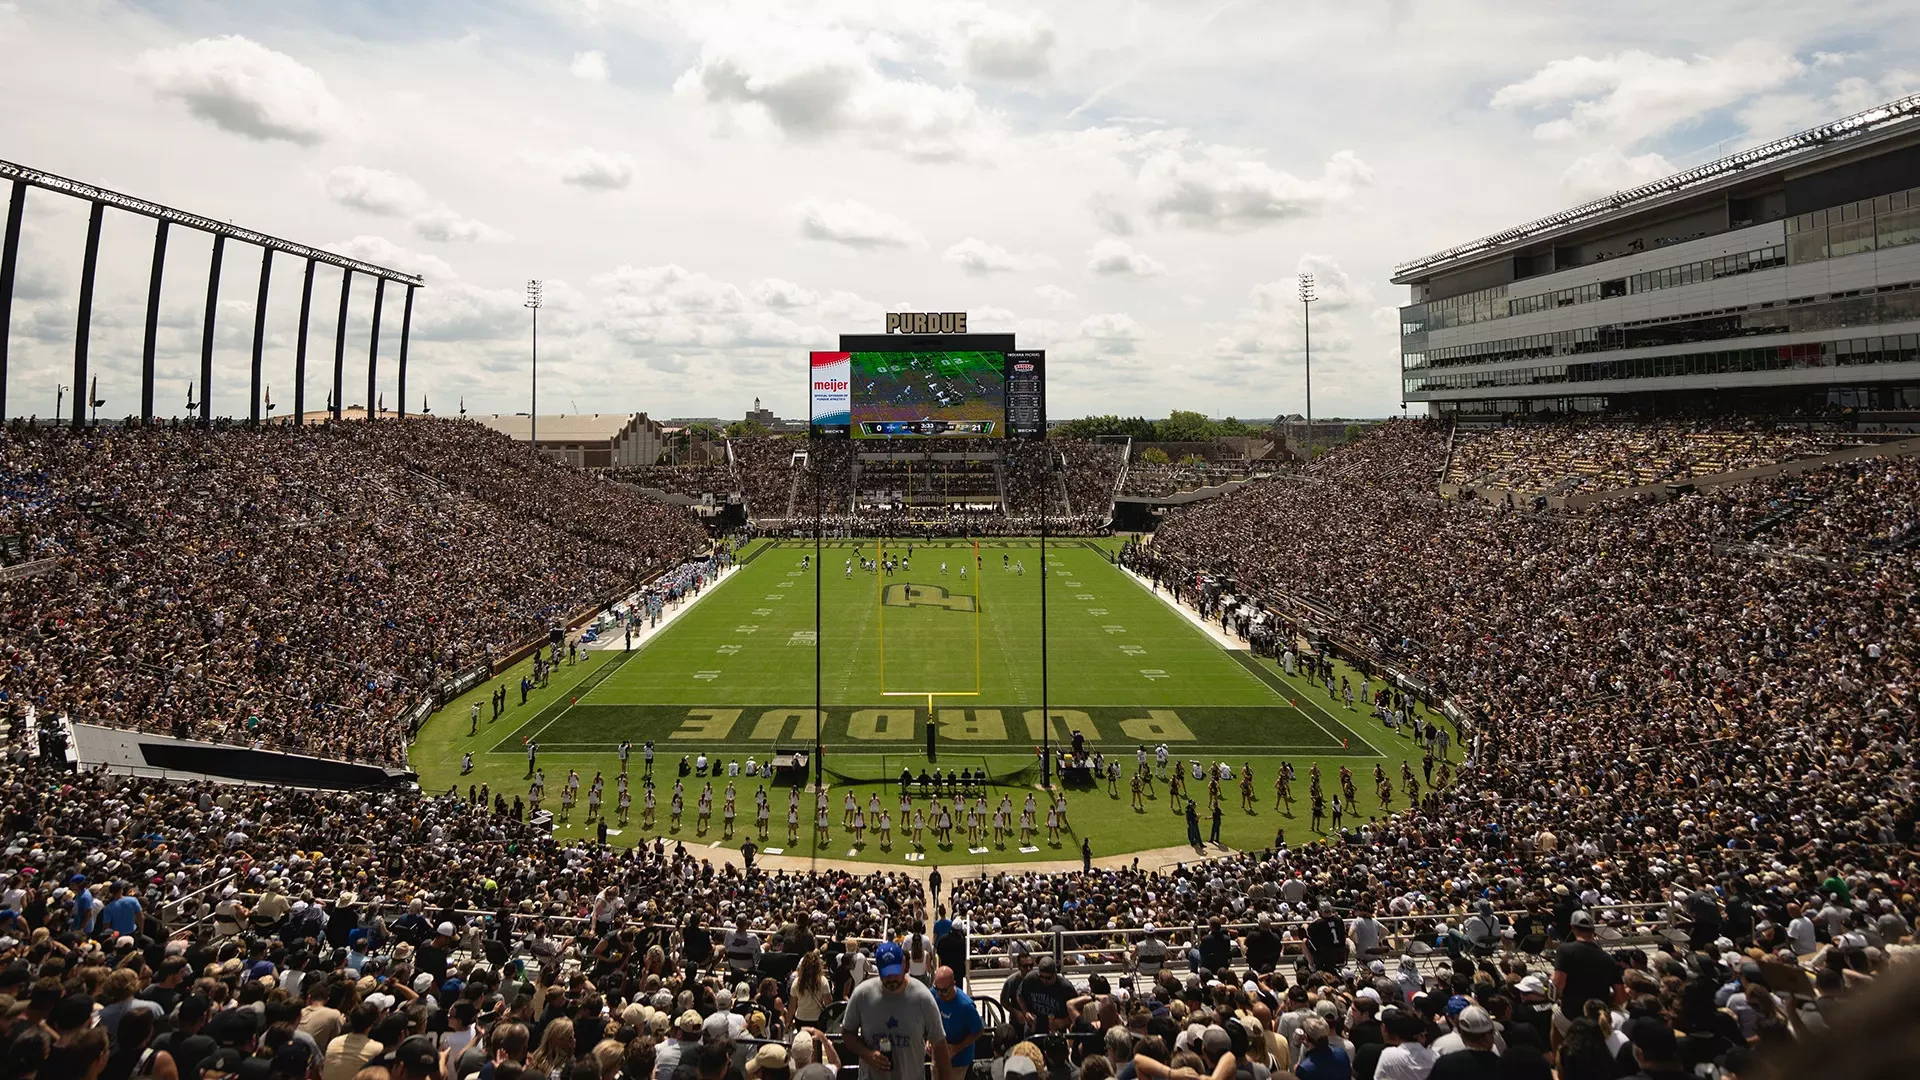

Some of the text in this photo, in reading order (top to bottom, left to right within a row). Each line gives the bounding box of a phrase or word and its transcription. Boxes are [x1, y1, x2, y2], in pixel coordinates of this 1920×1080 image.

[886, 312, 967, 334] PURDUE
[814, 379, 848, 392] meijer
[693, 670, 722, 679] 10
[1139, 669, 1170, 678] 10
[668, 708, 1198, 740] PURDUE
[645, 930, 662, 947] 21
